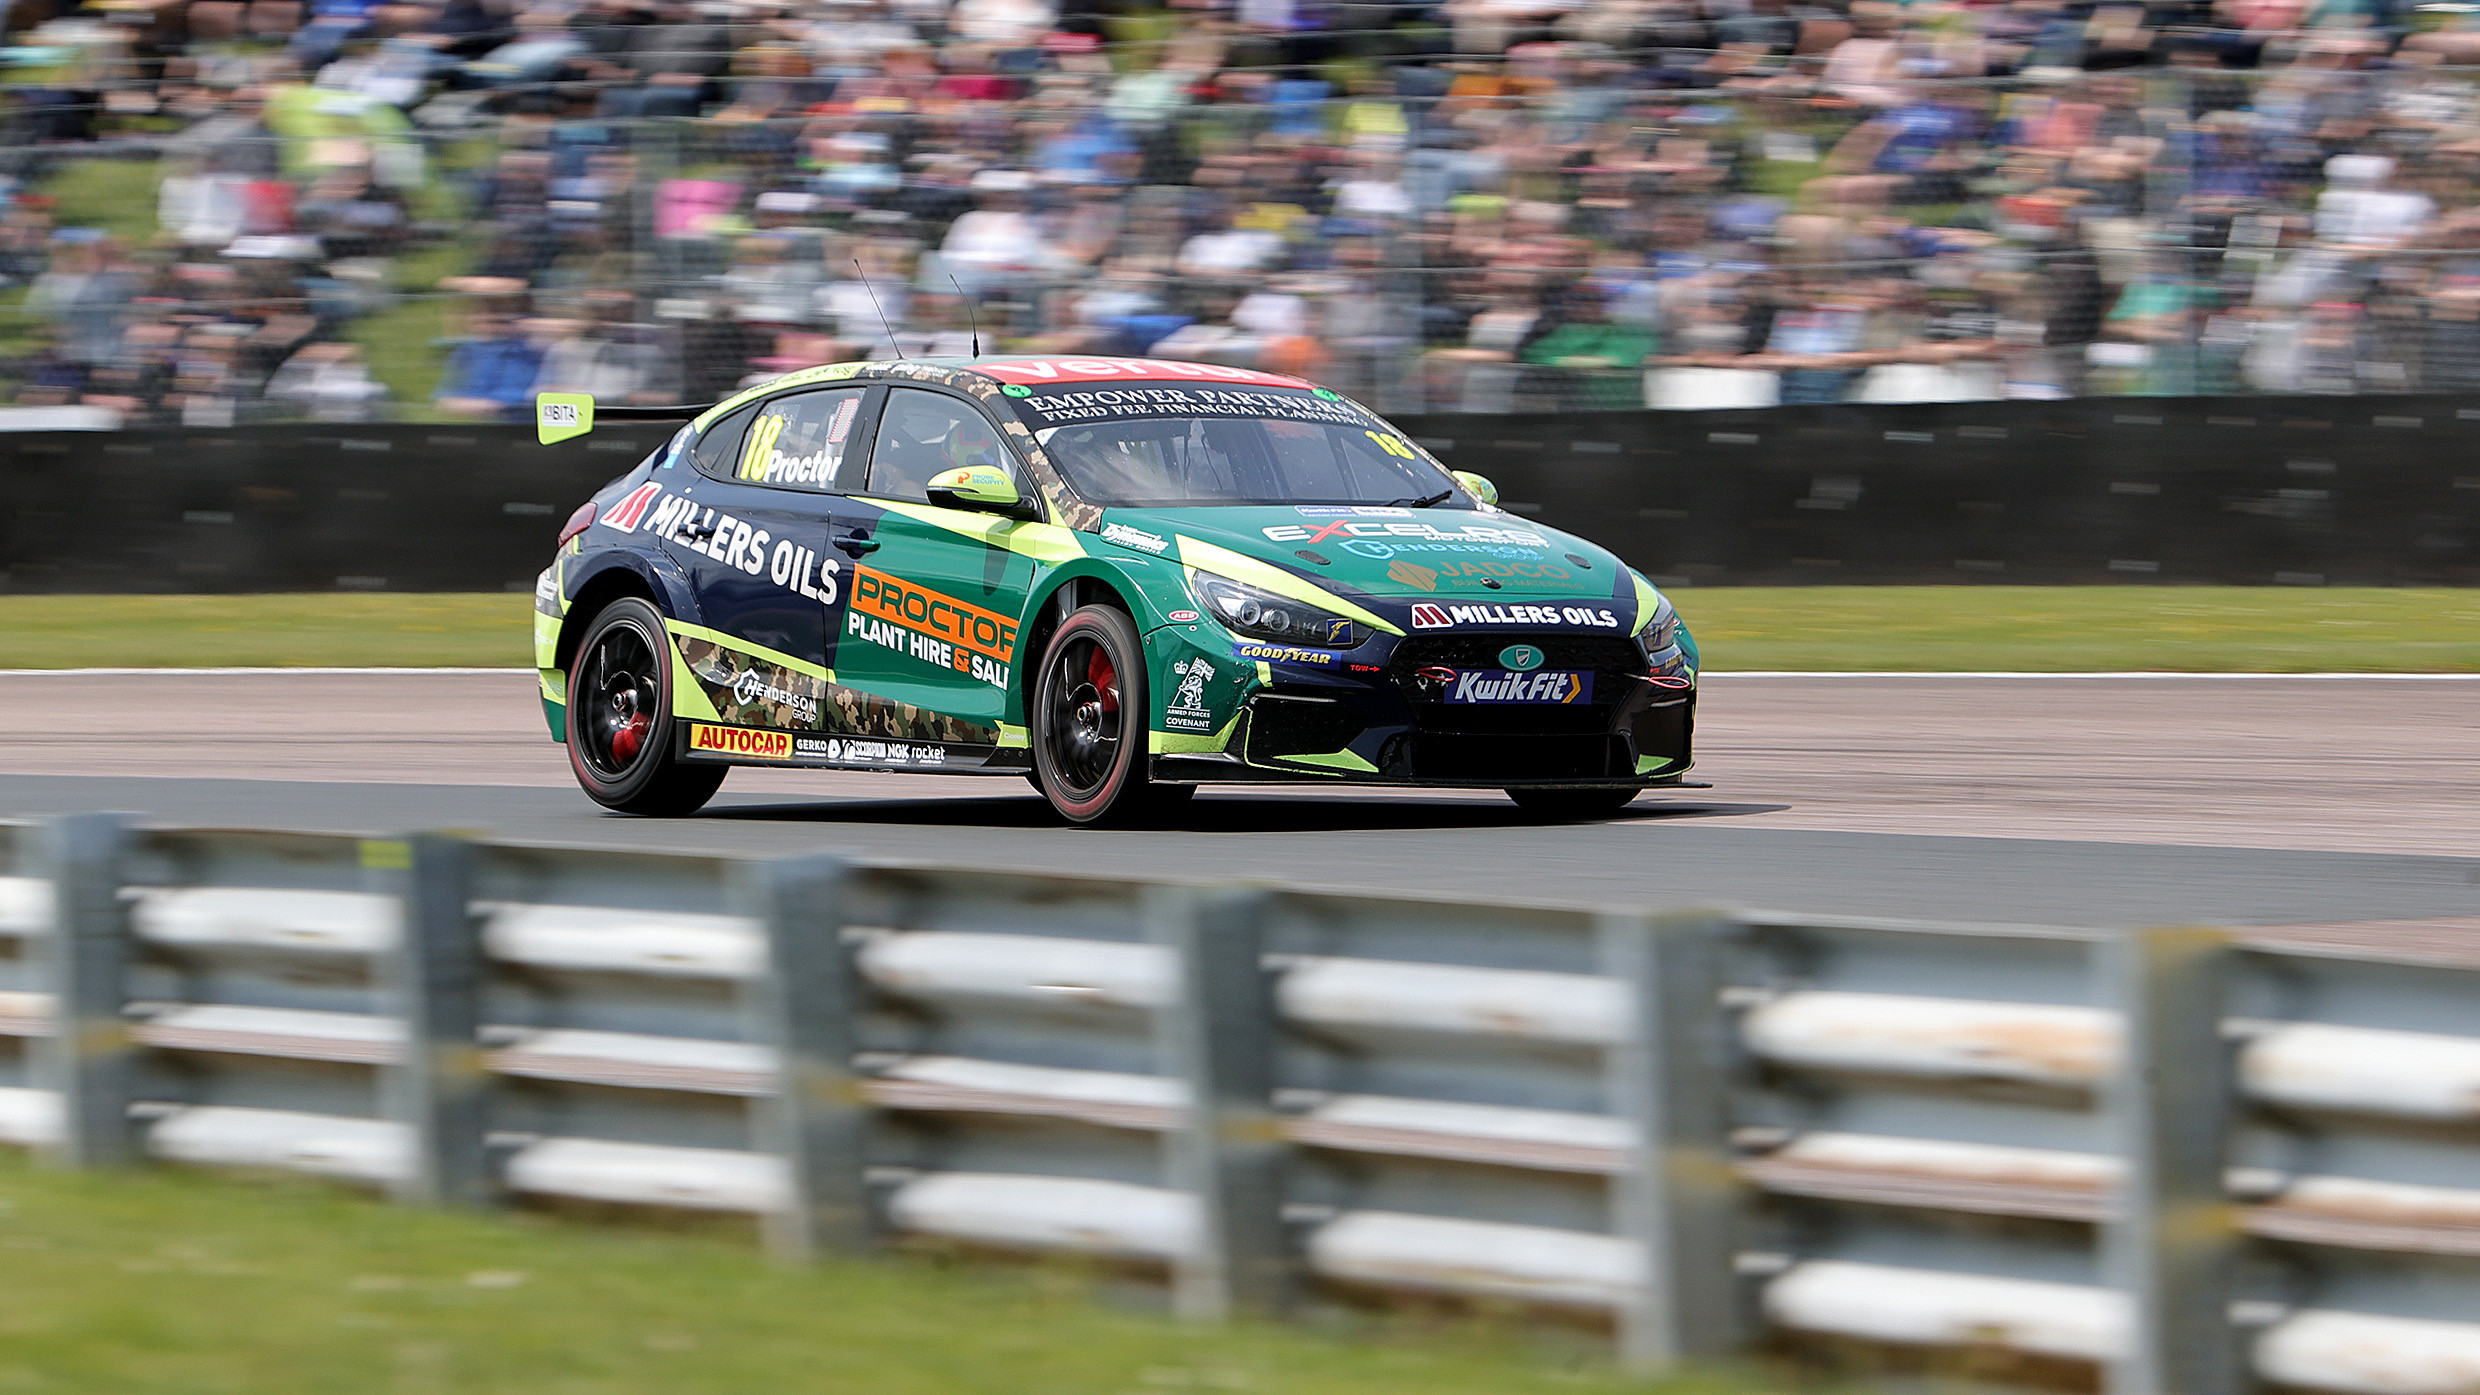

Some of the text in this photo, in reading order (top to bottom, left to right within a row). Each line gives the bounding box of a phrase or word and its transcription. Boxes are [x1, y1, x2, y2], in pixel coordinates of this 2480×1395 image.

[988, 361, 1255, 380] vertu
[1024, 388, 1357, 417] EMPOWER PARTNERS
[1041, 403, 1368, 427] FIXED FEE FINANCIAL PLANNING
[740, 414, 784, 481] 18
[1365, 430, 1416, 460] 18
[763, 449, 843, 482] Proctor
[642, 493, 841, 605] MILLERS OILS
[1365, 544, 1539, 556] HENDERSON
[1440, 561, 1571, 580] JADCO
[1449, 605, 1619, 628] MILLERS OILS
[848, 611, 907, 652] PLANT
[910, 632, 952, 669] HIRE
[953, 647, 970, 674] &
[1240, 646, 1332, 665] GOODYEAR
[1351, 664, 1369, 672] TOW
[744, 678, 817, 713] HENDERSON
[792, 708, 817, 723] GROUP
[1165, 717, 1211, 728] COVENANT
[1166, 708, 1211, 719] ARMED FORCES
[699, 726, 788, 756] AUTOCAR
[796, 738, 828, 752] GERKO
[887, 743, 910, 759] NGK
[911, 744, 946, 761] rocket
